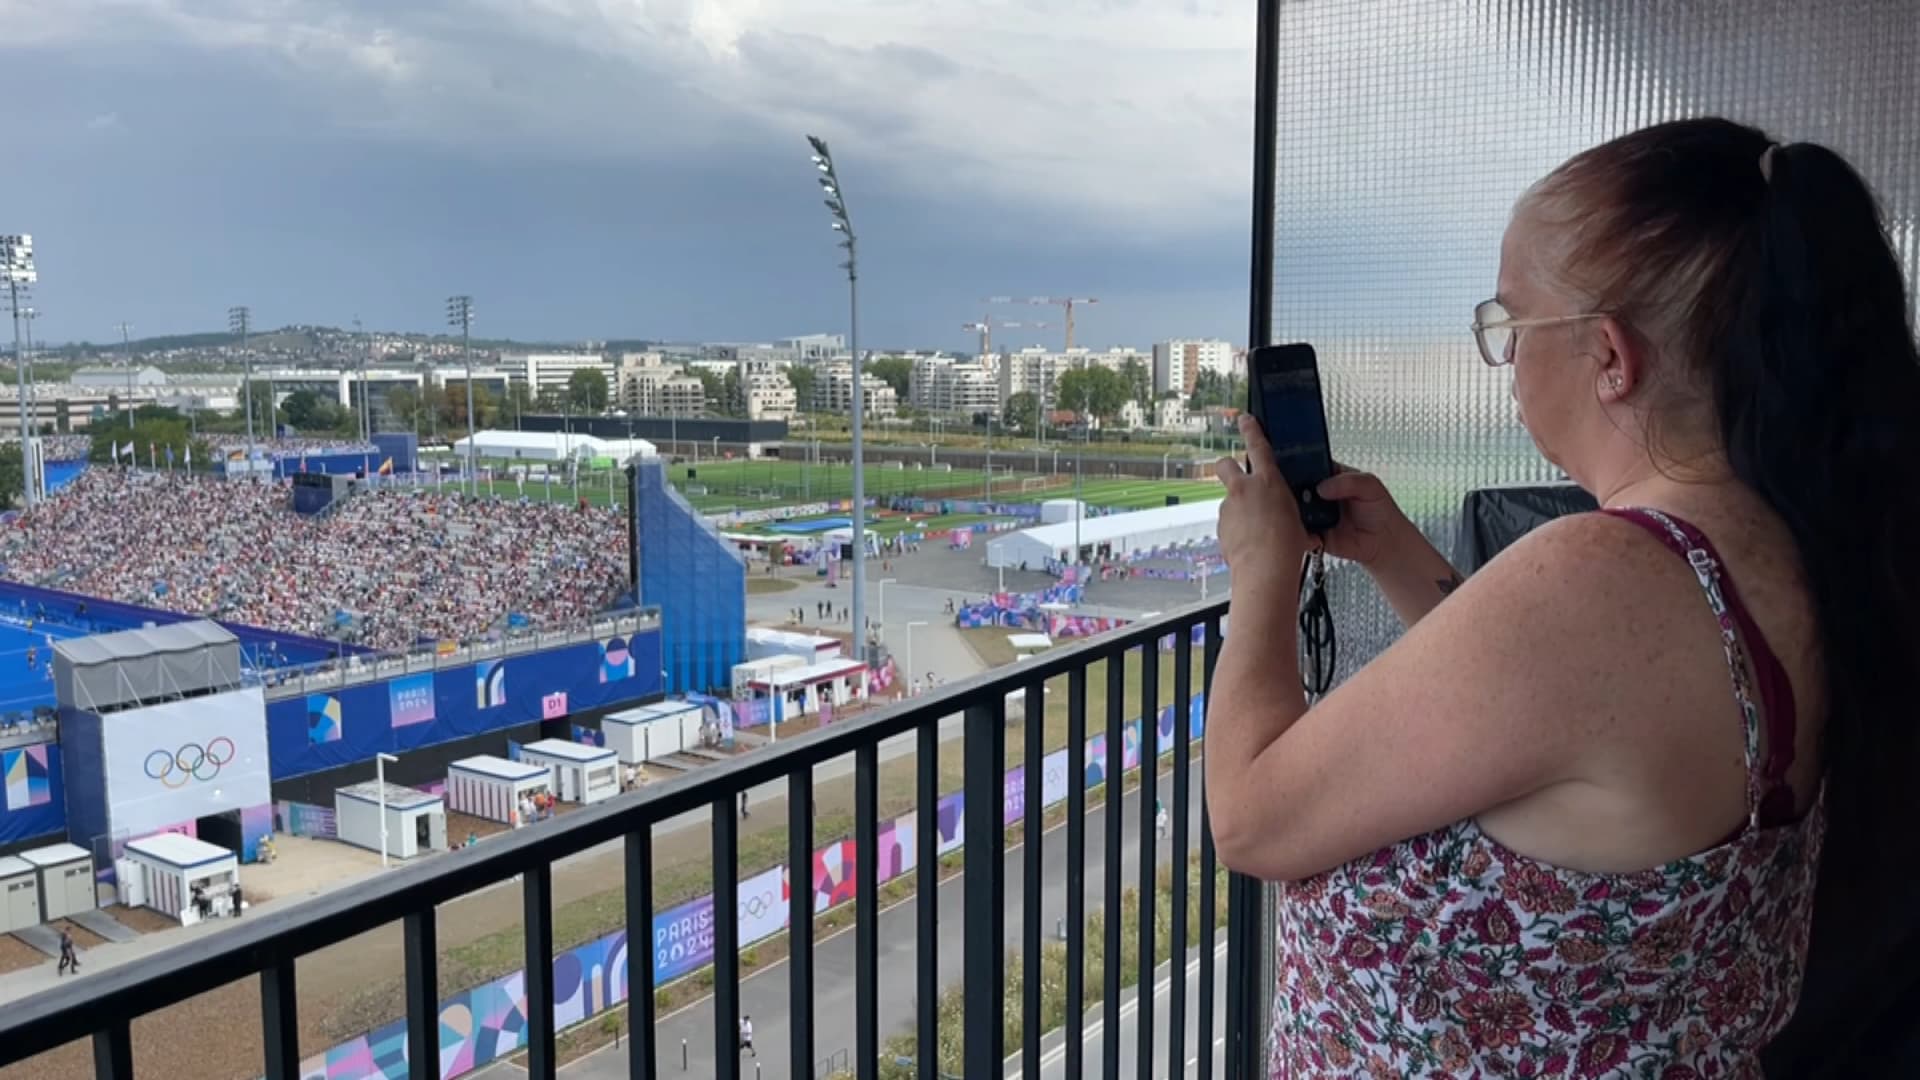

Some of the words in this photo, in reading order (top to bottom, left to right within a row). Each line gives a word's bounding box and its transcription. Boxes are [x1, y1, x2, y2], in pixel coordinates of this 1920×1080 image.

[548, 698, 561, 710] D1
[657, 909, 709, 949] PARIS
[657, 932, 709, 969] 2024
